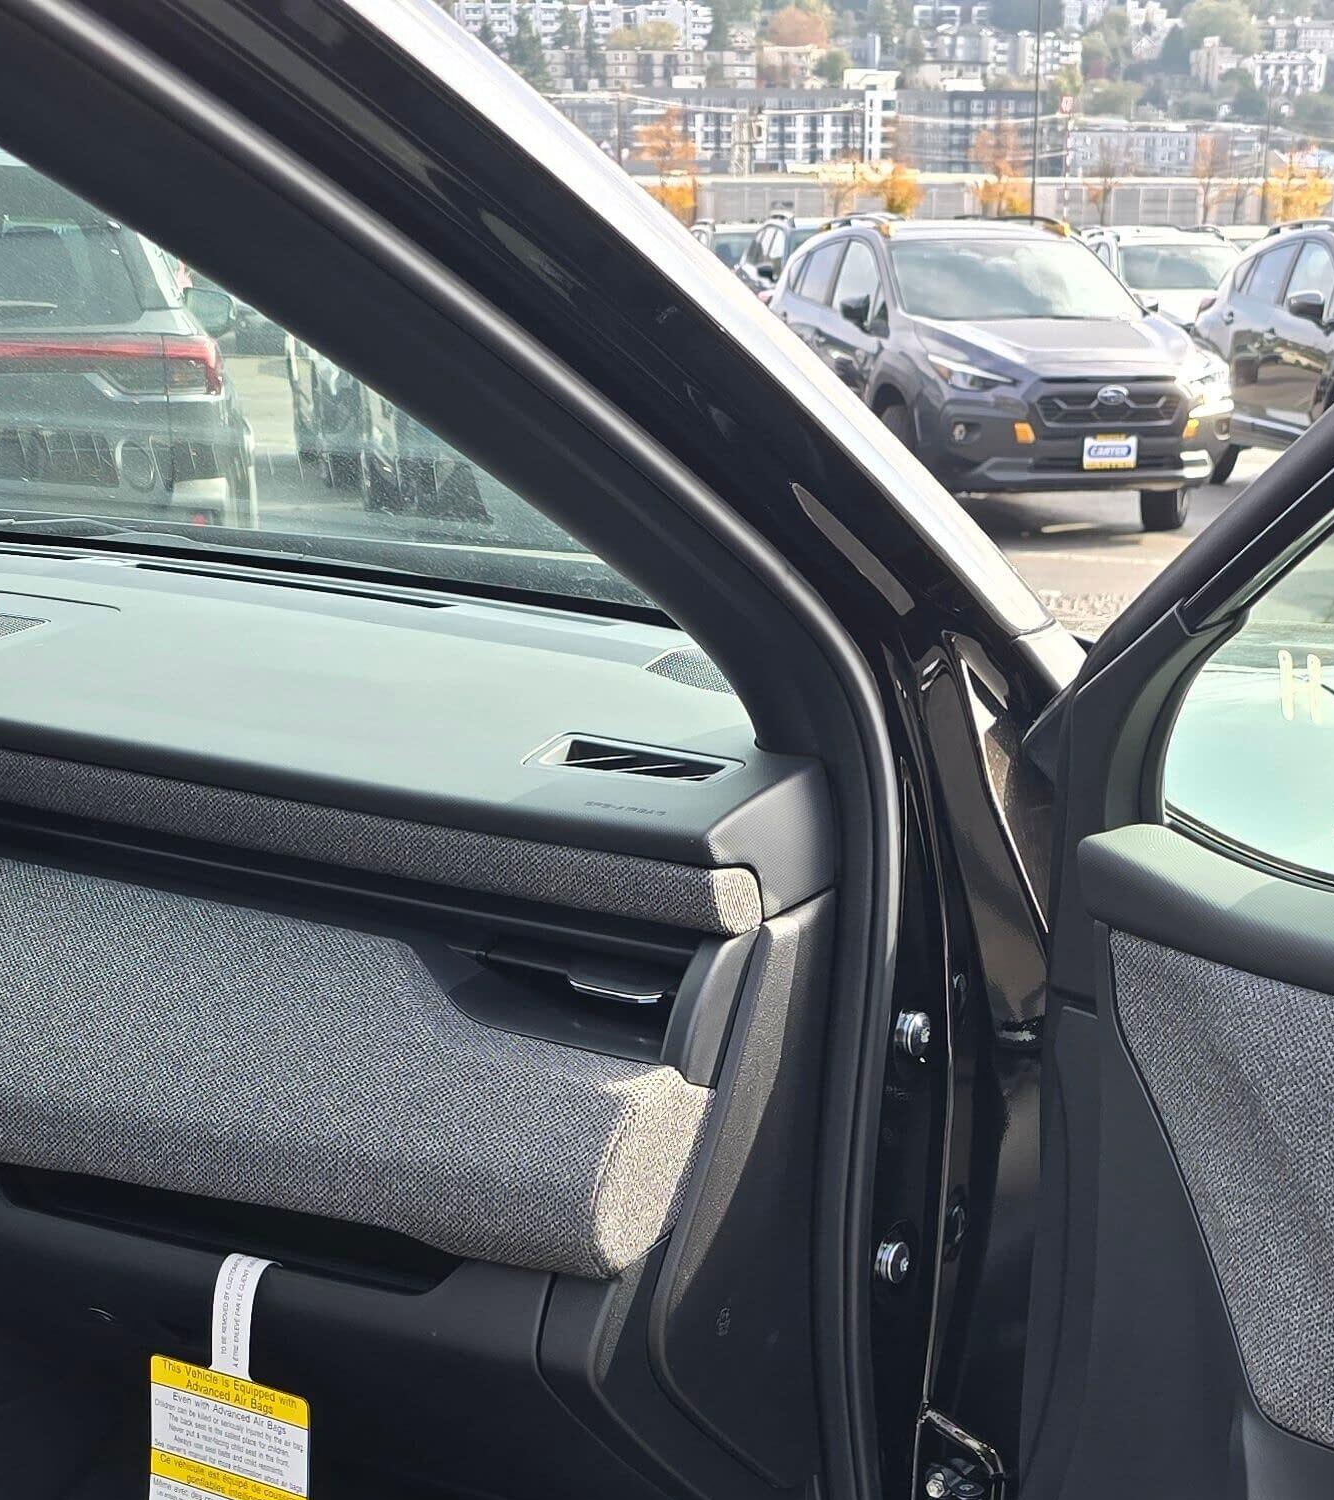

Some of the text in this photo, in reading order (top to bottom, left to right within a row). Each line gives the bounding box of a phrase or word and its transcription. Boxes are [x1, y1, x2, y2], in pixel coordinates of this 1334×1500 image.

[163, 1359, 296, 1408] This Vehicle is Equipped with
[186, 1379, 273, 1416] Advanced Air Bags
[172, 1392, 286, 1436] Even with Advanced Air Bags
[160, 1453, 170, 1465] Ce
[207, 1469, 219, 1480] est
[251, 1485, 260, 1494] de
